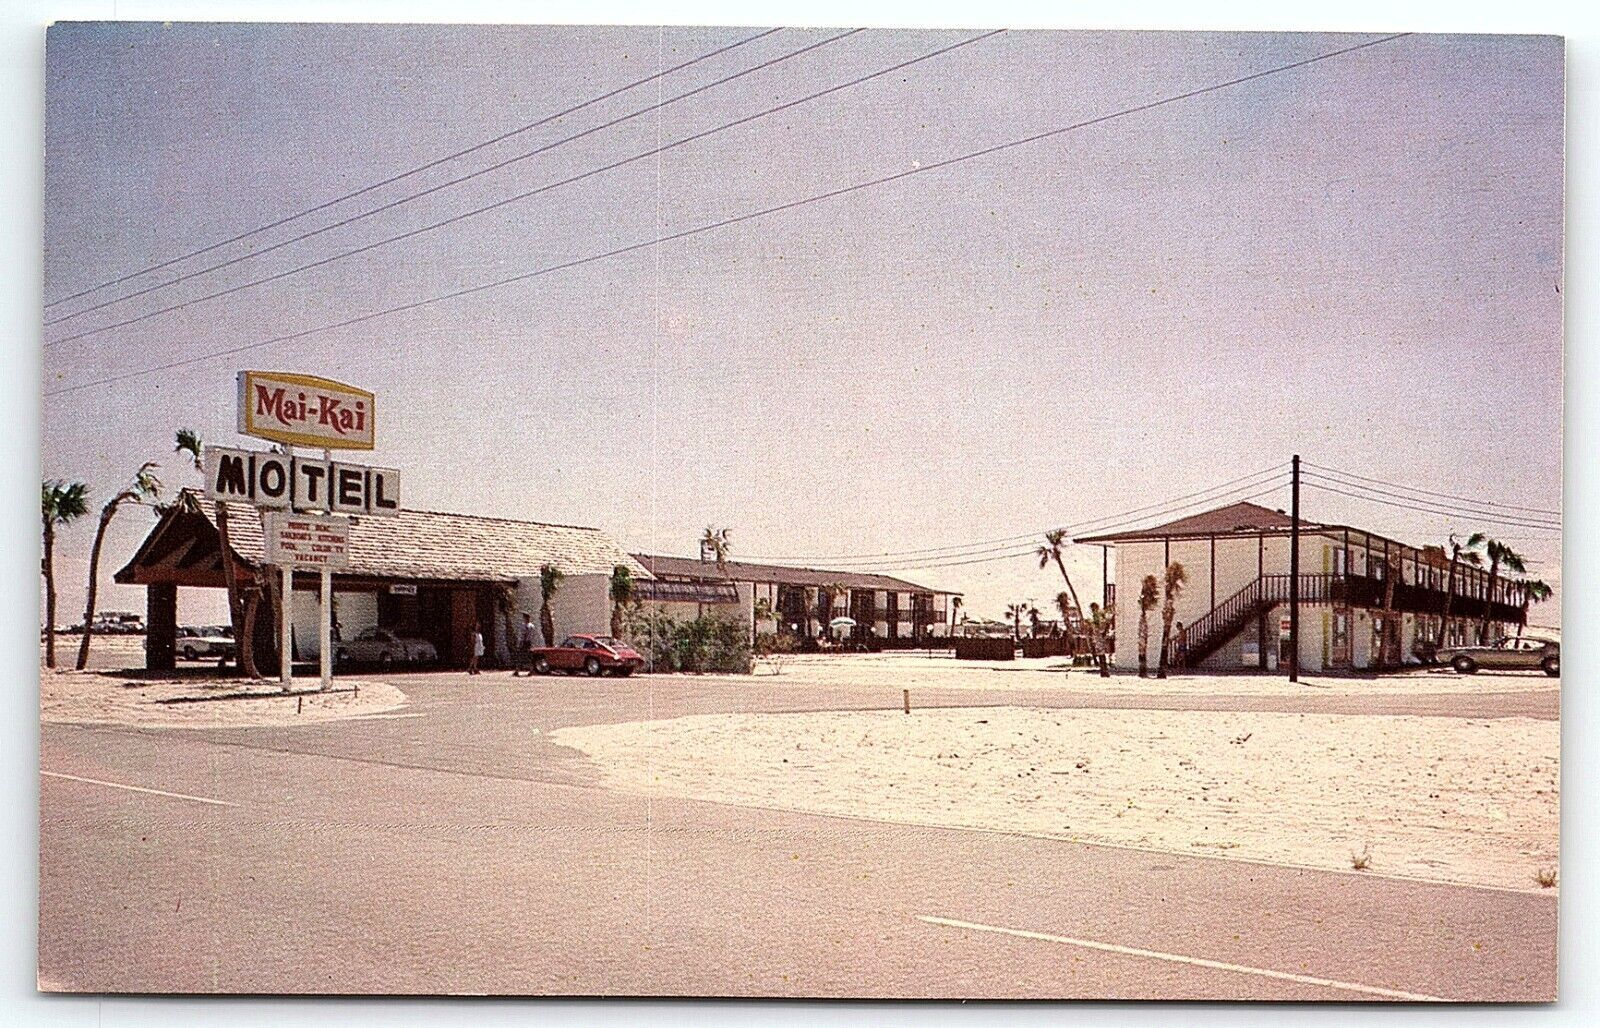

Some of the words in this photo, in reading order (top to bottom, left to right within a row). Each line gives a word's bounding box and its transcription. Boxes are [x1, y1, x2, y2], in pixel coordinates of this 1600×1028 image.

[254, 384, 367, 435] Mai-Kai
[215, 454, 397, 509] MOTEL
[294, 554, 328, 563] VACANCY
